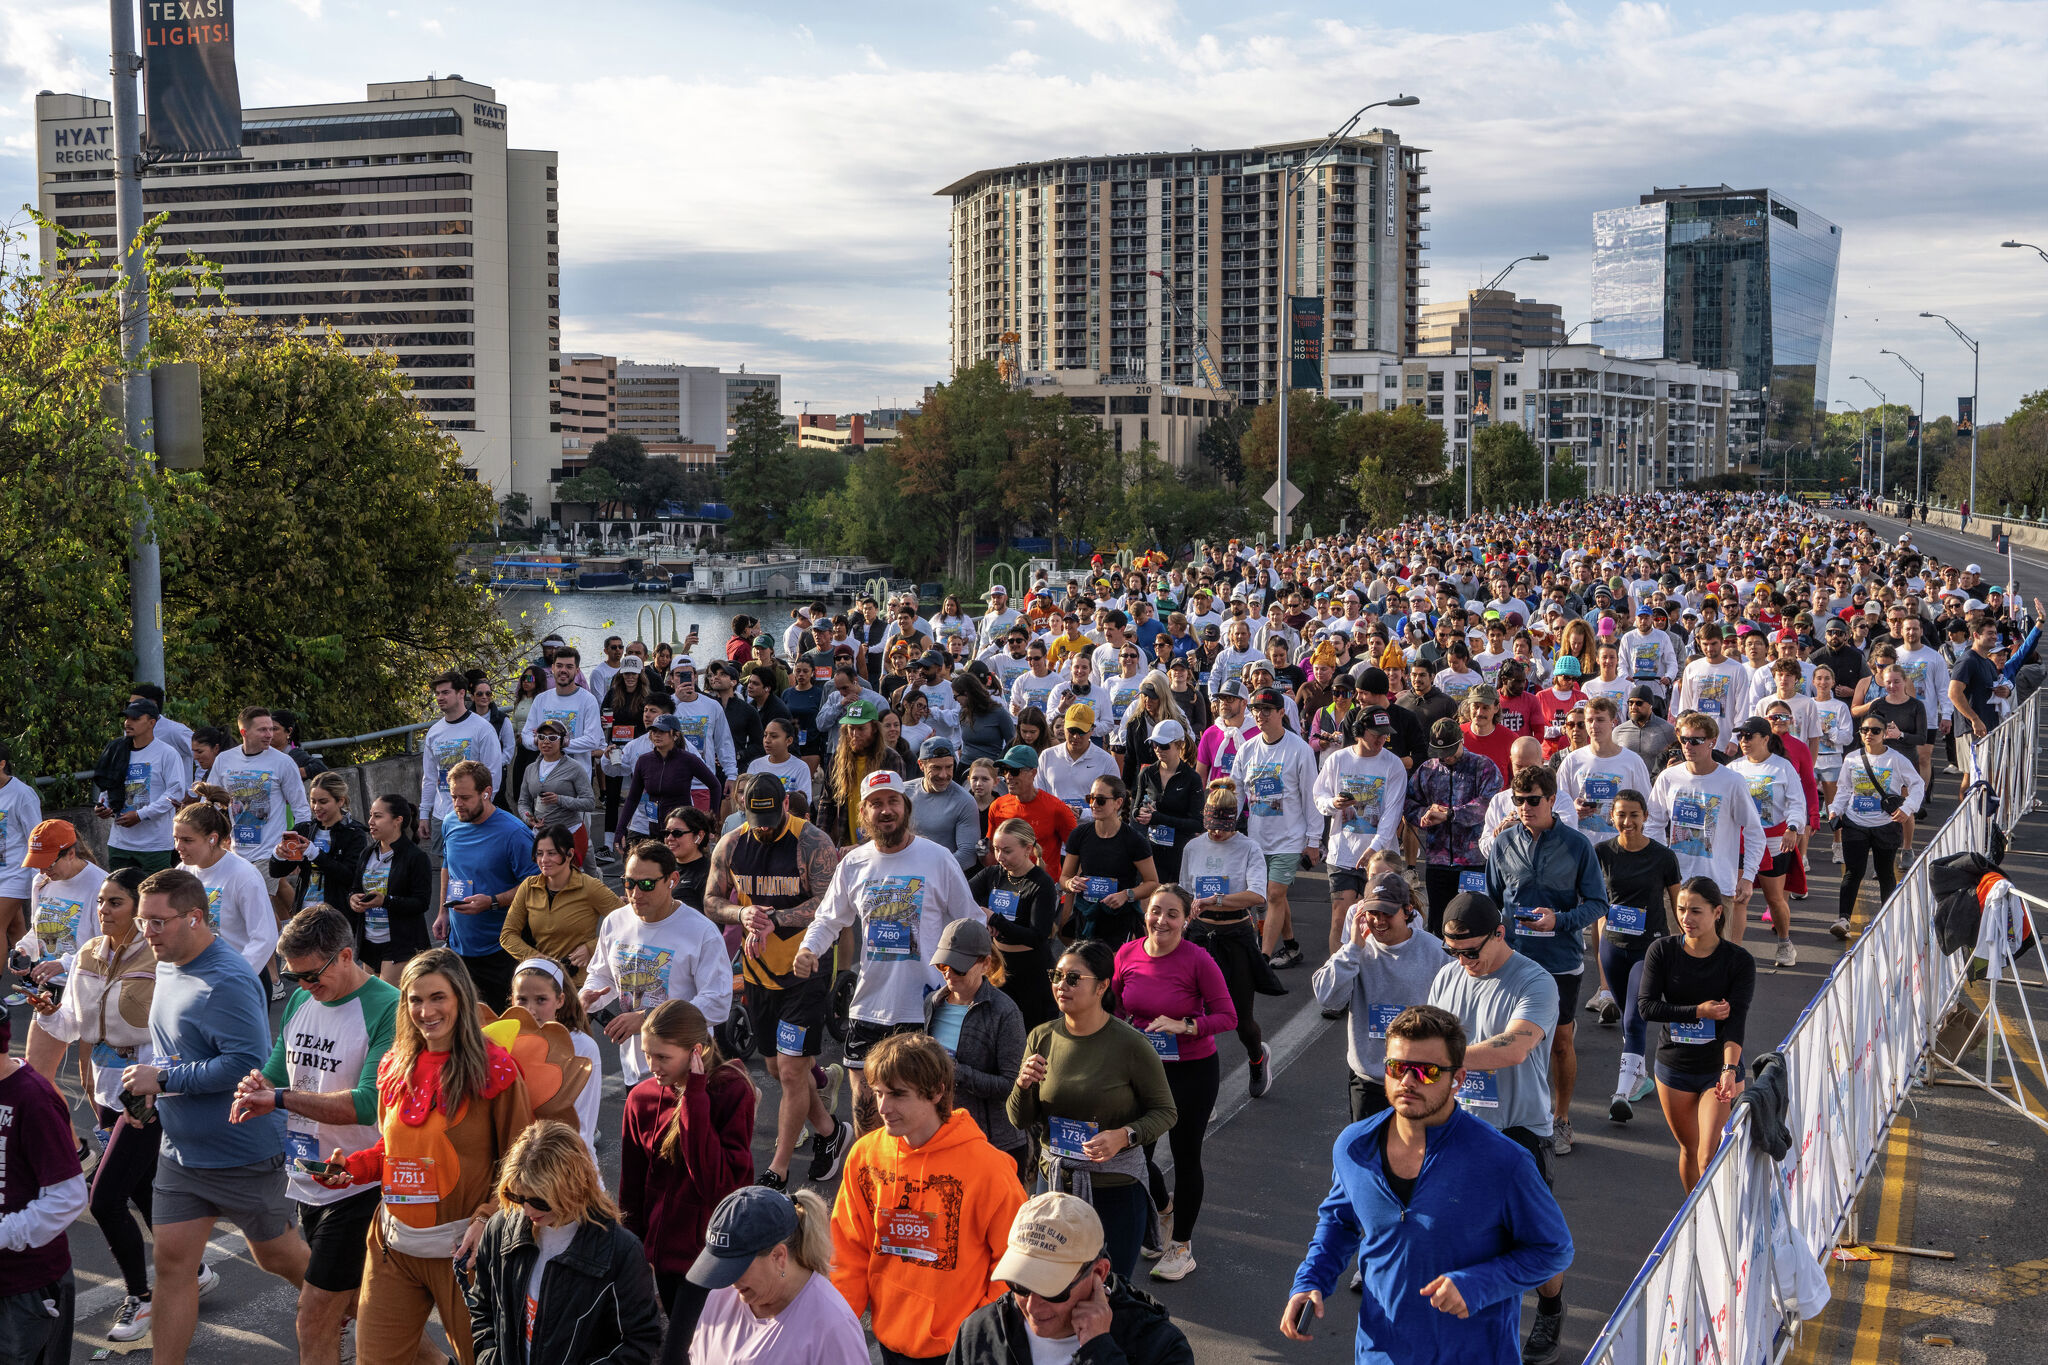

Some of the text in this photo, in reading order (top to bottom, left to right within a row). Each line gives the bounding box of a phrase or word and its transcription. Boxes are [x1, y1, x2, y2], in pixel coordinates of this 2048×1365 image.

[149, 0, 224, 21] TEXAS!
[147, 23, 229, 46] LIGHTS!
[474, 103, 505, 120] HYATT
[474, 117, 506, 131] REGENCY
[55, 126, 114, 147] HYAT
[55, 149, 114, 163] REGENC
[1136, 386, 1152, 394] 210
[1033, 617, 1050, 626] TEXA
[1501, 718, 1522, 732] EEF
[1681, 809, 1697, 818] 1448
[1091, 883, 1109, 892] 3222
[994, 898, 1010, 908] 4639
[1616, 913, 1637, 923] 3299
[877, 930, 900, 940] 7480
[296, 1032, 335, 1054] TEAM
[780, 1031, 796, 1043] 4640
[1061, 1128, 1087, 1143] 1736
[298, 1144, 307, 1156] 26
[393, 1171, 425, 1184] 17511
[889, 1222, 930, 1239] 18995
[1030, 1231, 1046, 1241] 2010
[1036, 1223, 1047, 1233] THE
[1046, 1226, 1068, 1245] ISLAND
[1040, 1241, 1058, 1252] RACE
